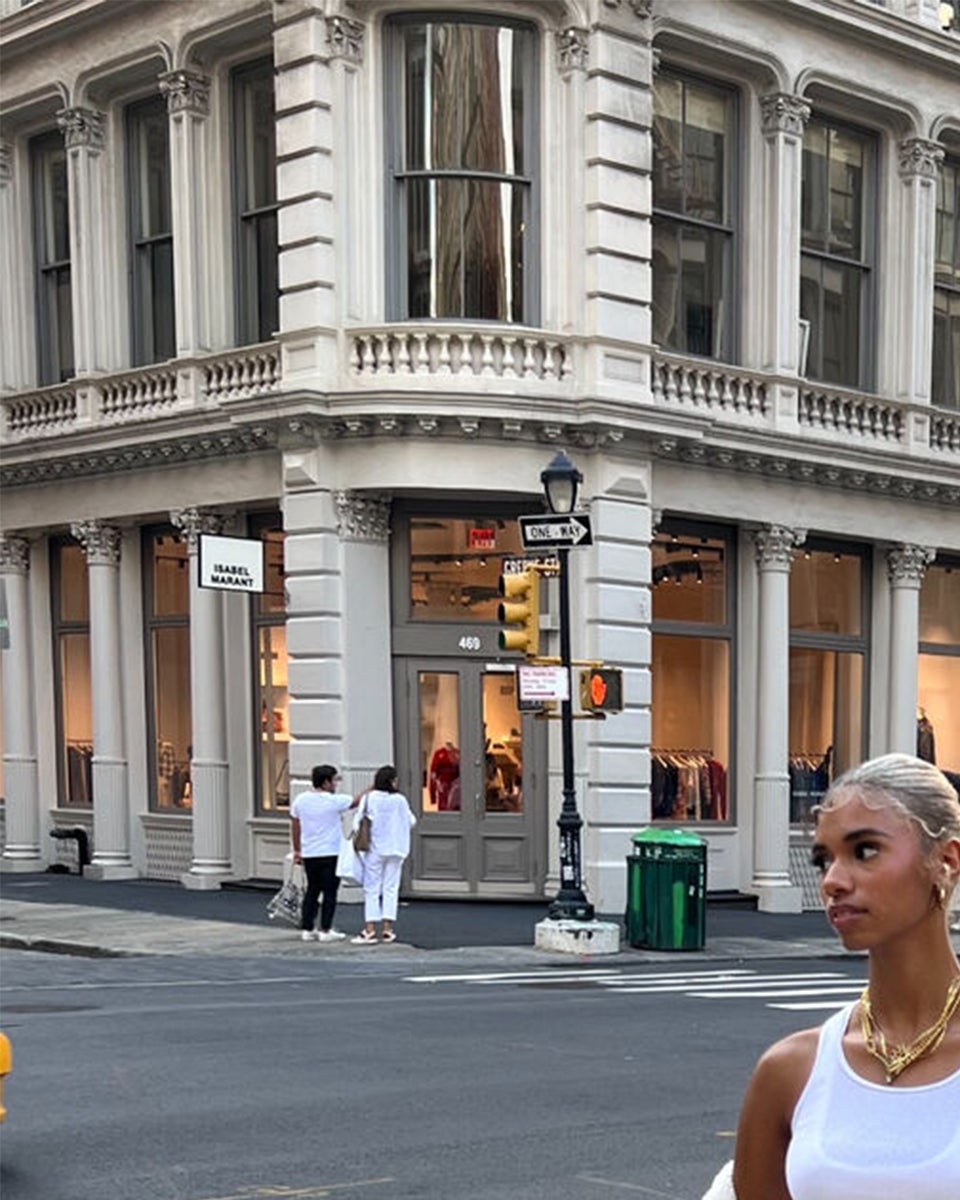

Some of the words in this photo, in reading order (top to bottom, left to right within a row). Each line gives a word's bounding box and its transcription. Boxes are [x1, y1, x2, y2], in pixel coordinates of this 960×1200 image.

[532, 526, 552, 538] ONE
[559, 526, 580, 537] WAY
[214, 564, 249, 576] ISABEL
[211, 574, 253, 587] MARANT
[459, 636, 480, 650] 469
